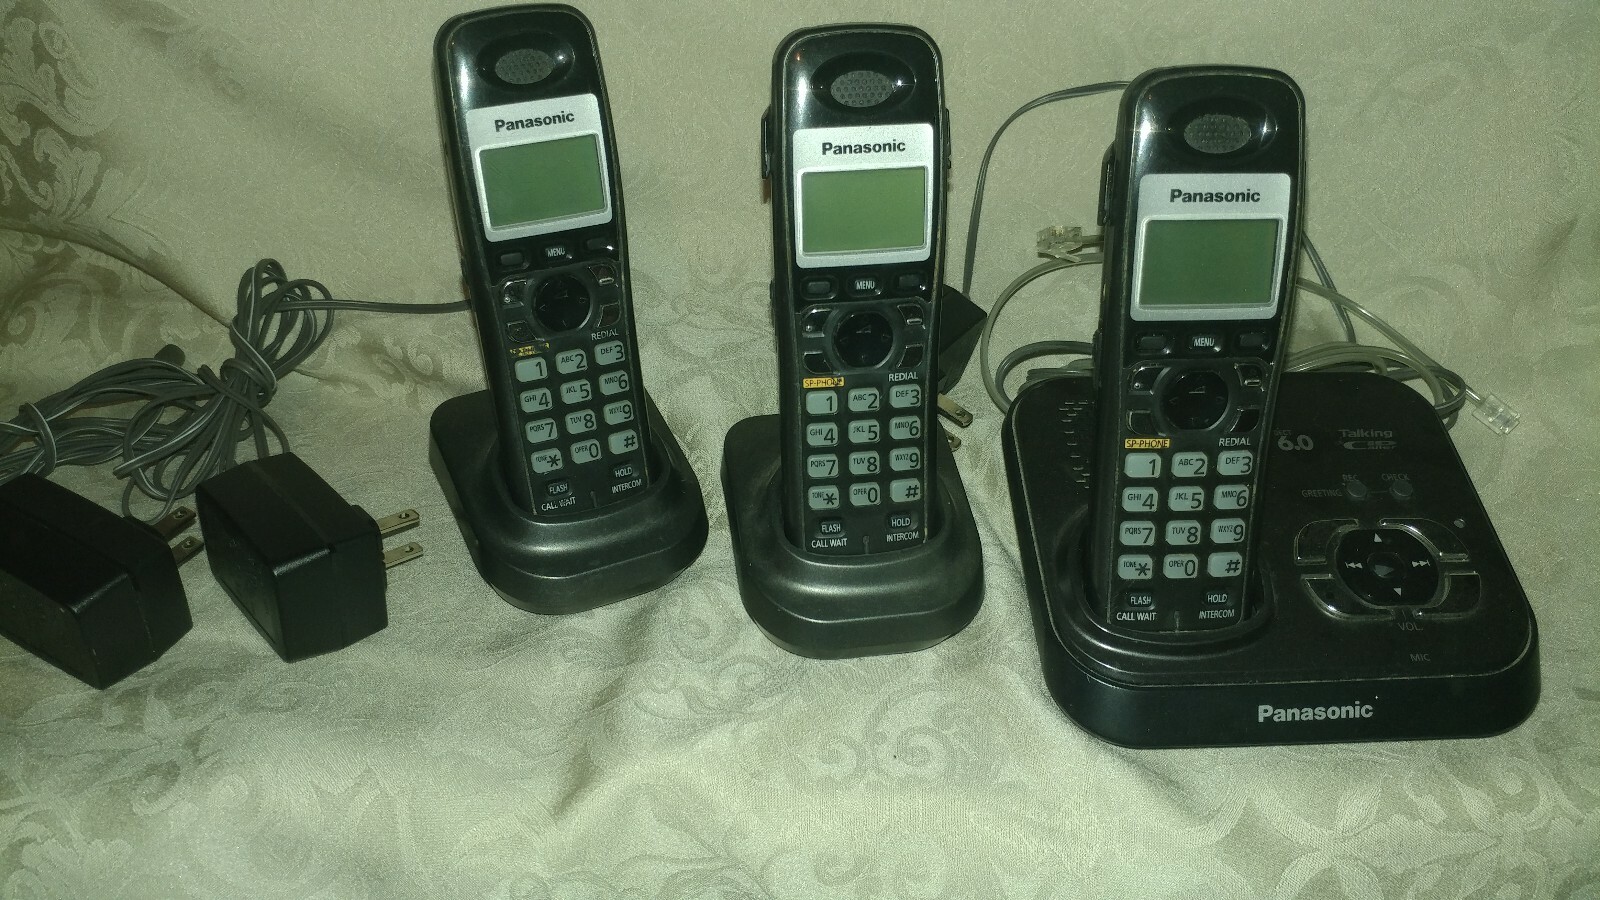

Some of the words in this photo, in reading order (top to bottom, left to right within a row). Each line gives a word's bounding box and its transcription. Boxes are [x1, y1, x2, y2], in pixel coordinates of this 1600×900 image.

[495, 111, 574, 132] Panasonic
[822, 139, 905, 155] Panasonic
[1170, 189, 1260, 202] Panasonic
[547, 248, 565, 257] MENU
[855, 281, 875, 289] MENU
[592, 329, 618, 340] REDIAL
[1194, 338, 1215, 347] MENU
[614, 345, 624, 360] 3
[536, 362, 543, 376] 1
[561, 355, 574, 363] ABC
[575, 354, 586, 369] 2
[605, 376, 618, 384] MNO
[618, 374, 628, 389] 6
[889, 372, 918, 381] REDIAL
[580, 383, 589, 398] 5
[896, 390, 909, 398] DEF
[910, 389, 919, 405] 3
[538, 393, 550, 407] 4
[826, 396, 832, 411] 1
[868, 393, 877, 409] 2
[622, 404, 632, 419] 9
[570, 416, 582, 424] TUV
[584, 414, 594, 428] 8
[909, 421, 919, 436] 6
[545, 422, 554, 437] 7
[824, 428, 835, 443] 4
[868, 425, 878, 440] 5
[1338, 428, 1393, 439] Talking
[1126, 440, 1168, 448] SP-PHONE
[1219, 438, 1251, 447] REDIAL
[1277, 434, 1314, 451] 6.0
[589, 443, 598, 458] 0
[826, 460, 836, 475] 7
[867, 457, 877, 472] 8
[910, 453, 919, 468] 9
[1149, 459, 1156, 475] 1
[1178, 458, 1193, 466] ABC
[1194, 458, 1206, 474] 2
[1225, 457, 1240, 465] DEF
[1240, 456, 1252, 473] 3
[615, 467, 632, 478] HOLD
[1381, 473, 1410, 481] CHECK
[549, 483, 568, 494] FLASH
[612, 479, 641, 494] INTERCOM
[1302, 489, 1342, 497] GREETING
[868, 488, 877, 502] 0
[1142, 494, 1154, 510] 4
[1191, 493, 1202, 509] 5
[1236, 490, 1246, 506] 6
[541, 501, 558, 511] CALL
[560, 497, 576, 508] WAIT
[822, 524, 840, 533] FLASH
[892, 518, 910, 527] HOLD
[887, 531, 919, 542] INTERCOM
[1125, 527, 1141, 535] PQRS
[1142, 527, 1153, 543] 7
[1187, 527, 1198, 543] 8
[1233, 524, 1244, 541] 9
[812, 540, 828, 548] CALL
[830, 538, 847, 547] WAIT
[1169, 560, 1184, 568] OPER
[1184, 560, 1195, 576] 0
[1131, 596, 1151, 605] FLASH
[1207, 594, 1227, 603] HOLD
[1116, 612, 1135, 621] CALL
[1137, 612, 1157, 621] WAIT
[1199, 609, 1235, 619] INTERCOM
[1410, 653, 1430, 662] MIC
[1258, 701, 1373, 723] Panasonic
